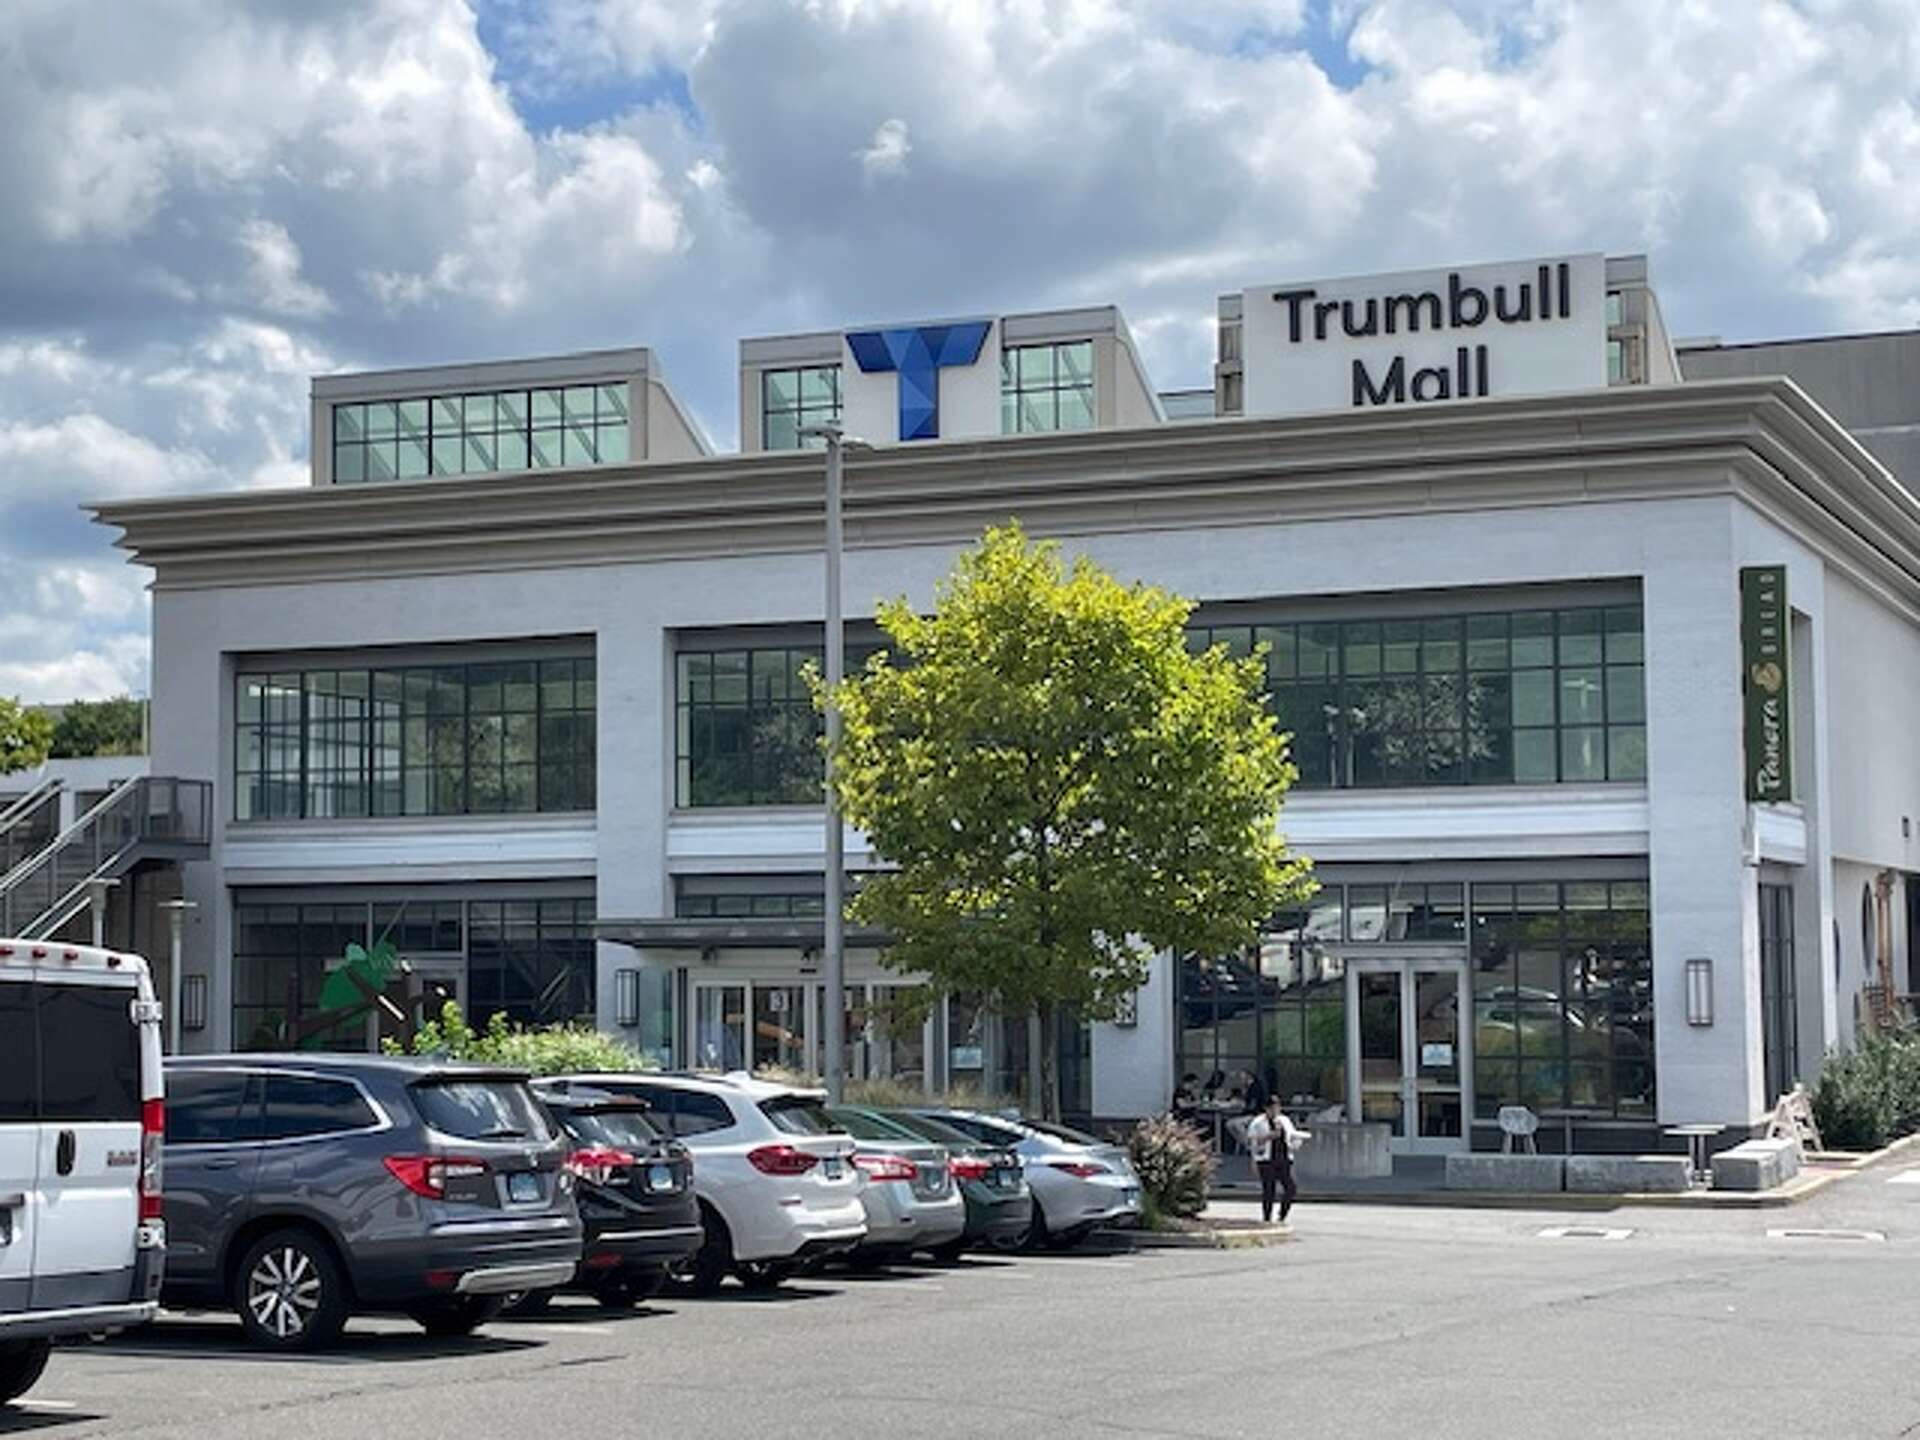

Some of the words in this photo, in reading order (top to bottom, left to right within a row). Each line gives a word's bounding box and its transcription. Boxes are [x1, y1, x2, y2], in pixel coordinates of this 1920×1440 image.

[1273, 262, 1571, 343] Trumbull
[1352, 345, 1489, 407] Mall
[1757, 699, 1781, 794] Panera
